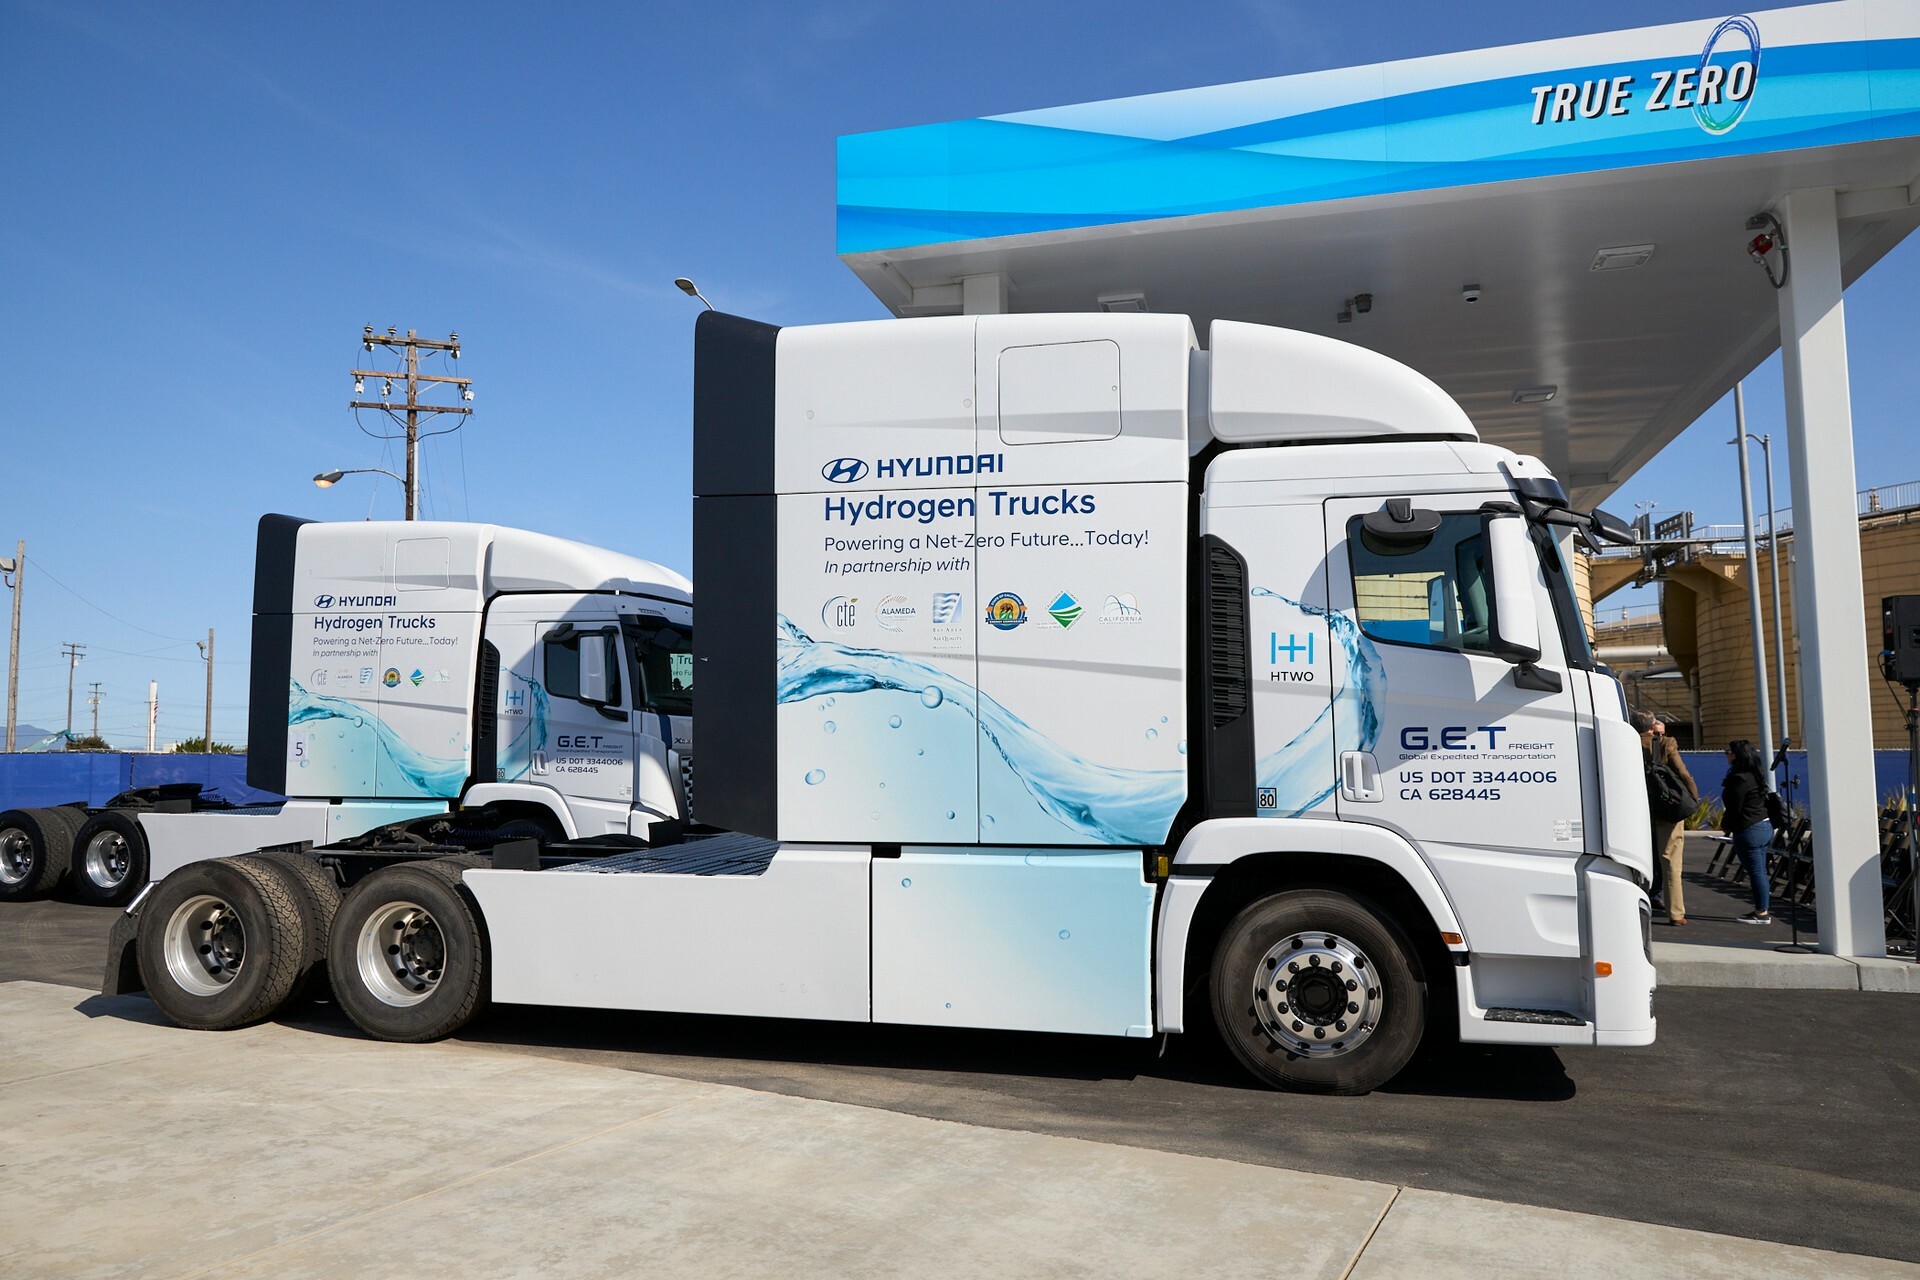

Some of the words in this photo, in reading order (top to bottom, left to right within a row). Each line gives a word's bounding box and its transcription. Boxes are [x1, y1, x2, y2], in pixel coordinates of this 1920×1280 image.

[1530, 75, 1635, 124] TRUE
[1645, 61, 1757, 111] ZERO
[877, 453, 1004, 479] HYUNDAI
[824, 494, 976, 526] Hydrogen
[988, 488, 1096, 517] Trucks
[824, 534, 905, 553] Powering
[909, 538, 921, 550] a
[926, 532, 1005, 549] Net-Zero
[1010, 529, 1149, 548] Future...Today!
[824, 559, 839, 574] In
[842, 557, 932, 576] partnership
[935, 557, 970, 572] with
[339, 595, 397, 607] HYUNDAI
[881, 607, 916, 615] ALAMEDA
[314, 616, 382, 632] Hydrogen
[388, 615, 436, 629] Trucks
[313, 636, 349, 647] Powering
[351, 638, 357, 646] a
[358, 637, 395, 646] Net-Zero
[312, 649, 319, 657] In
[320, 649, 361, 658] partnership
[362, 649, 378, 657] with
[1271, 671, 1314, 682] HTWO
[557, 735, 604, 749] G.E.T
[1400, 726, 1507, 751] G.E.T
[295, 741, 304, 757] 5
[556, 757, 567, 765] US
[569, 757, 584, 765] DOT
[586, 758, 624, 766] 3344006
[1398, 753, 1428, 761] Global
[1430, 753, 1479, 761] Expedited
[1481, 753, 1556, 761] Transportation
[555, 765, 566, 773] CA
[567, 766, 599, 774] 628445
[1400, 771, 1424, 783] US
[1431, 771, 1466, 783] DOT
[1472, 771, 1557, 784] 3344006
[1260, 793, 1275, 807] 80
[1400, 788, 1422, 801] CA
[1429, 788, 1501, 801] 628445
